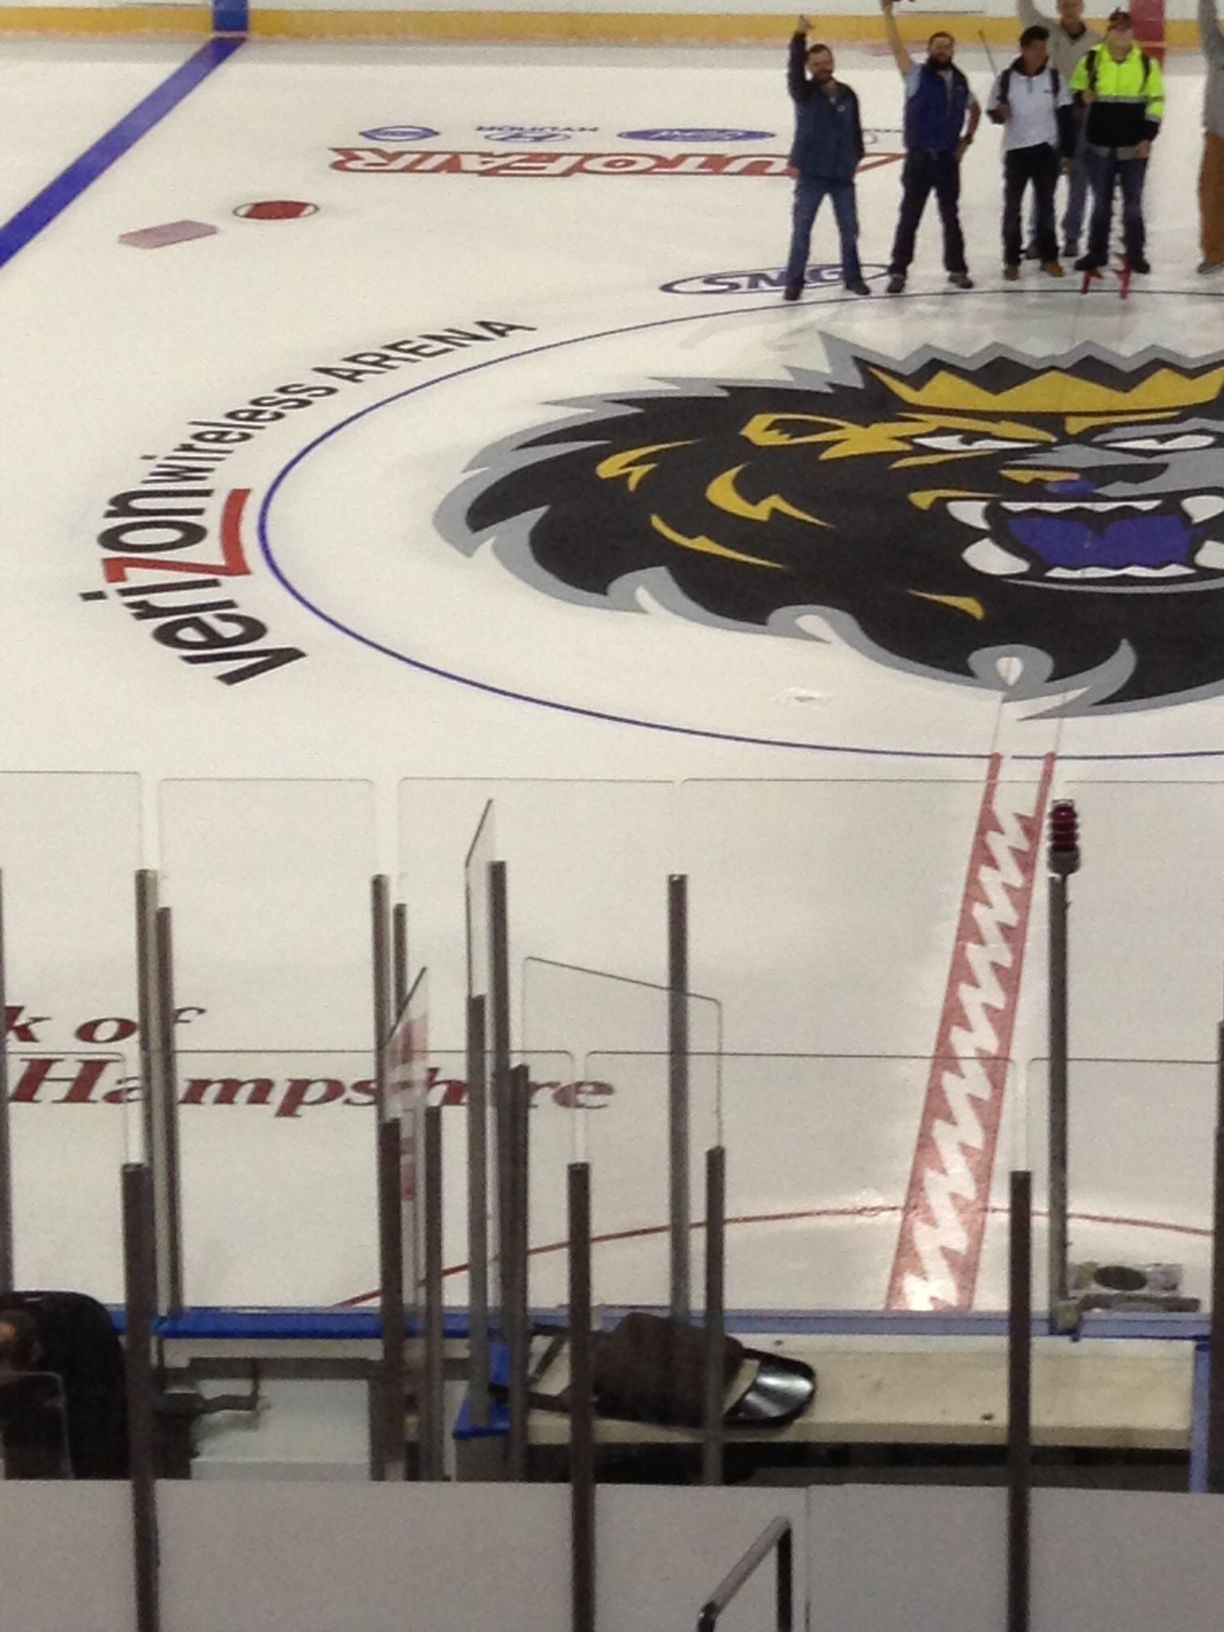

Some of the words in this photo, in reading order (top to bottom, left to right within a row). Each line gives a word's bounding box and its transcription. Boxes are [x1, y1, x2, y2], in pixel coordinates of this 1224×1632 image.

[312, 319, 538, 384] ARENA
[140, 383, 339, 484] wireless
[80, 488, 308, 686] verizon
[8, 1057, 615, 1118] Hampshre
